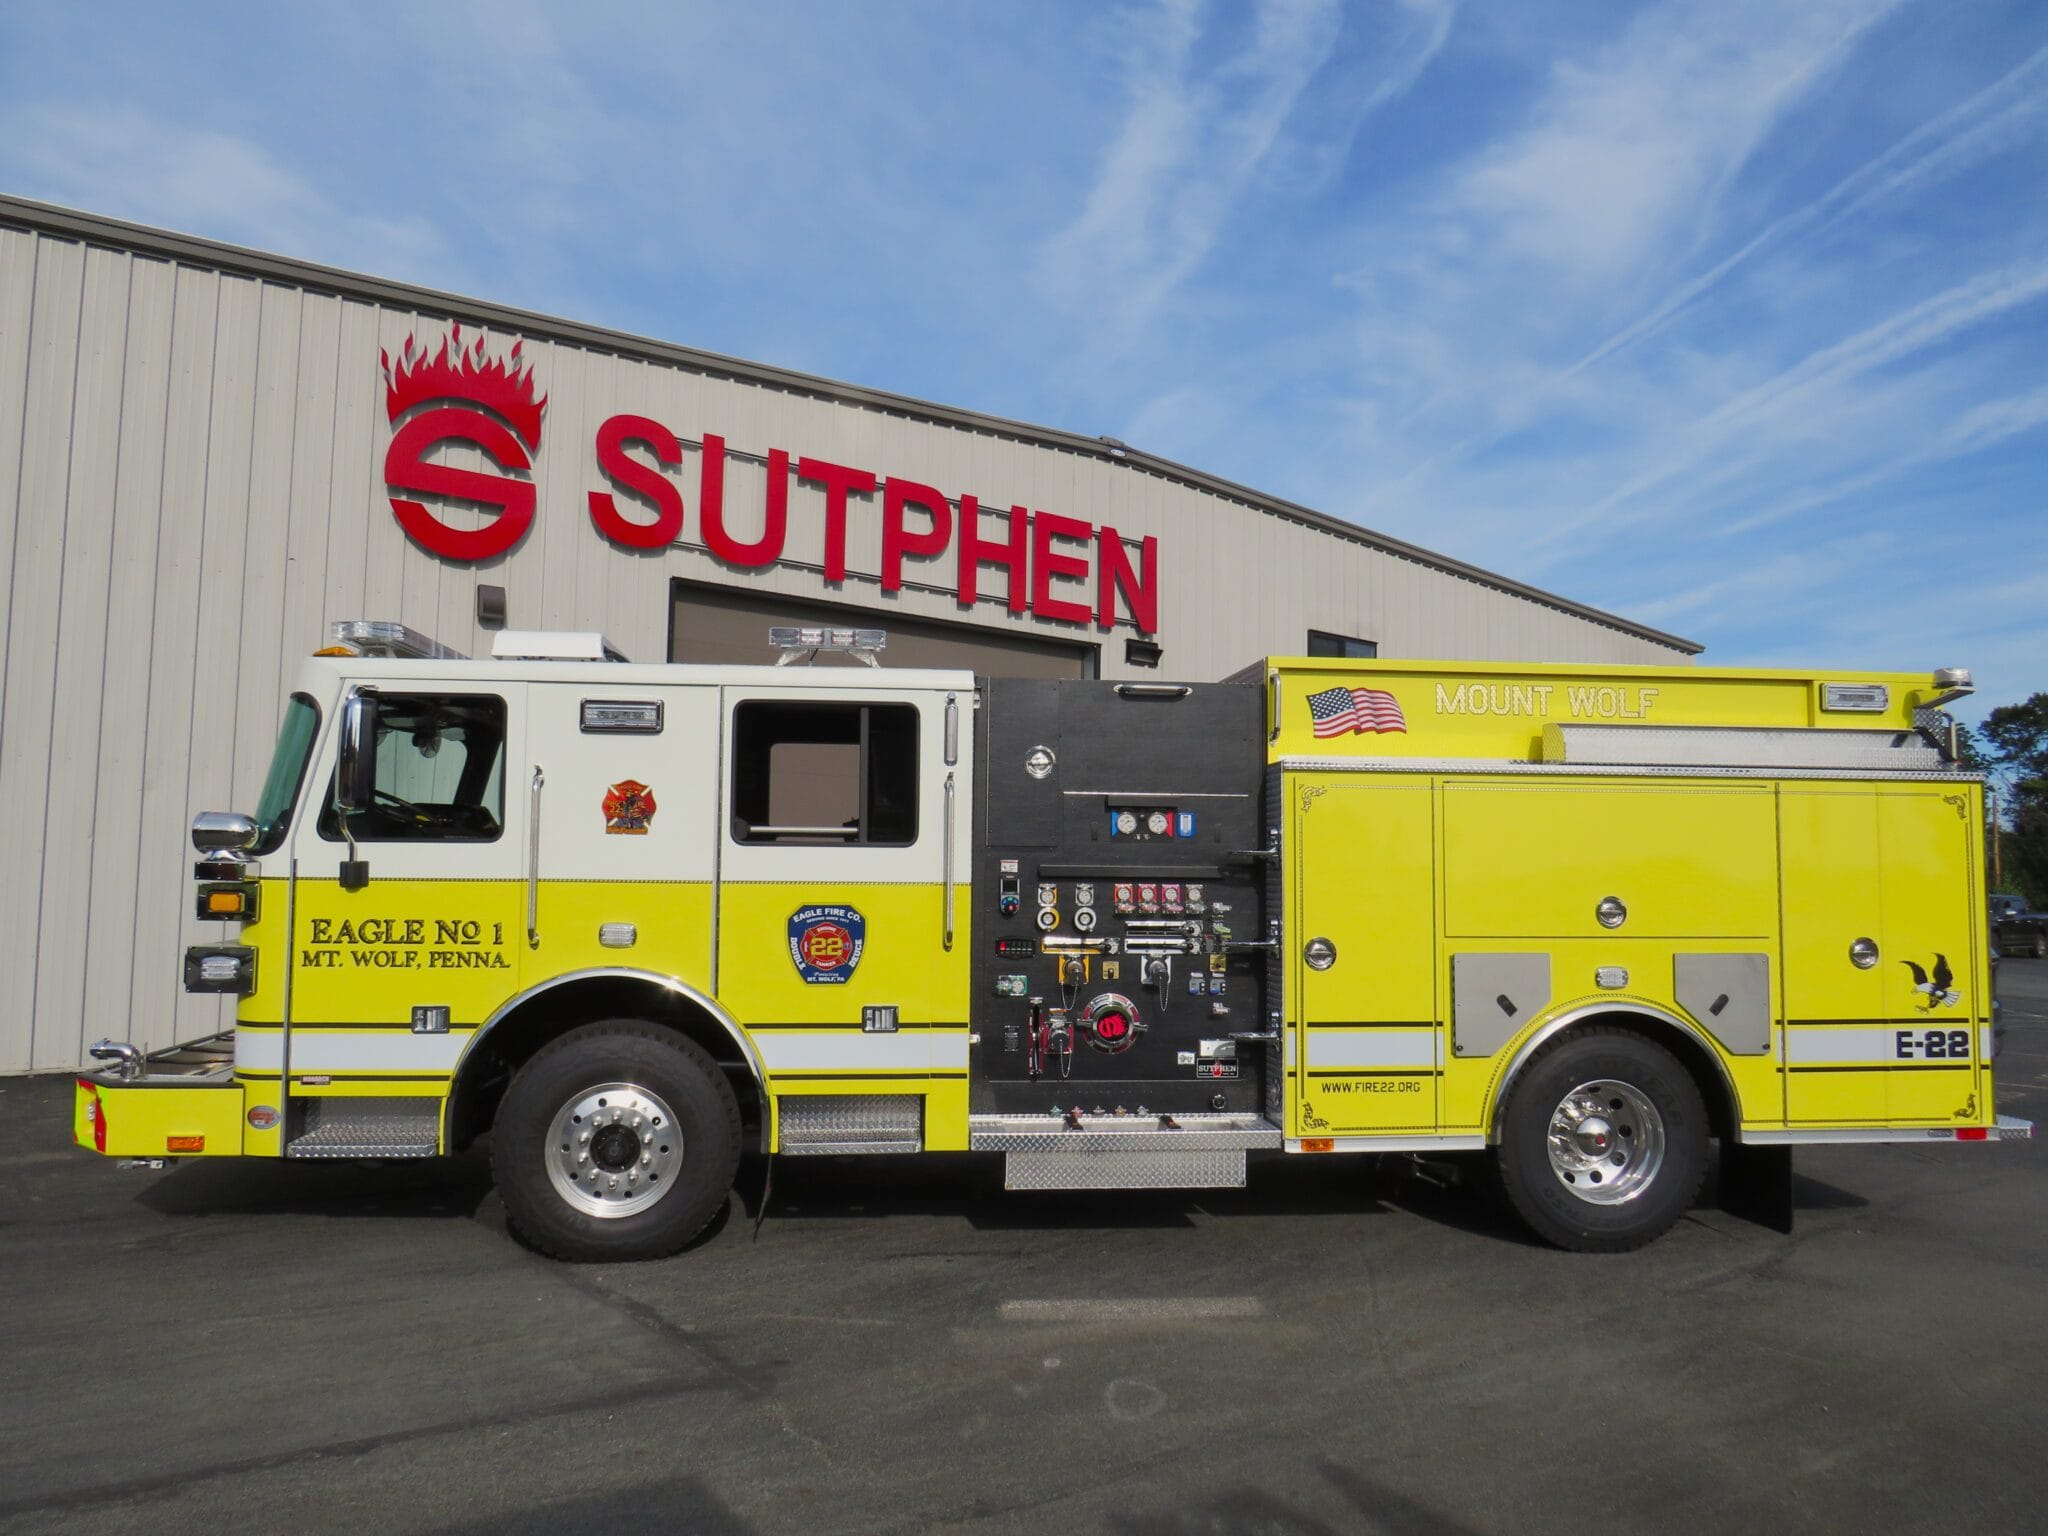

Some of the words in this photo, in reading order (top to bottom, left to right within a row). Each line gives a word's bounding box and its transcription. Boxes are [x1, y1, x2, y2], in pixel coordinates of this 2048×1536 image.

[588, 414, 1158, 634] SUTPHEN
[1435, 682, 1553, 716] MOUNT
[1567, 685, 1660, 720] WOLF
[793, 908, 823, 923] EAGLE
[824, 907, 846, 917] FIRE
[847, 911, 862, 923] CO.
[311, 919, 425, 945] EAGLE
[492, 921, 504, 945] 1
[810, 937, 843, 956] 22
[301, 950, 344, 969] MT.
[351, 950, 422, 970] WOLF,
[429, 951, 511, 969] PENNA.
[1896, 1031, 1969, 1058] E-22
[1321, 1081, 1421, 1094] WWW.FIRE22.ORG
